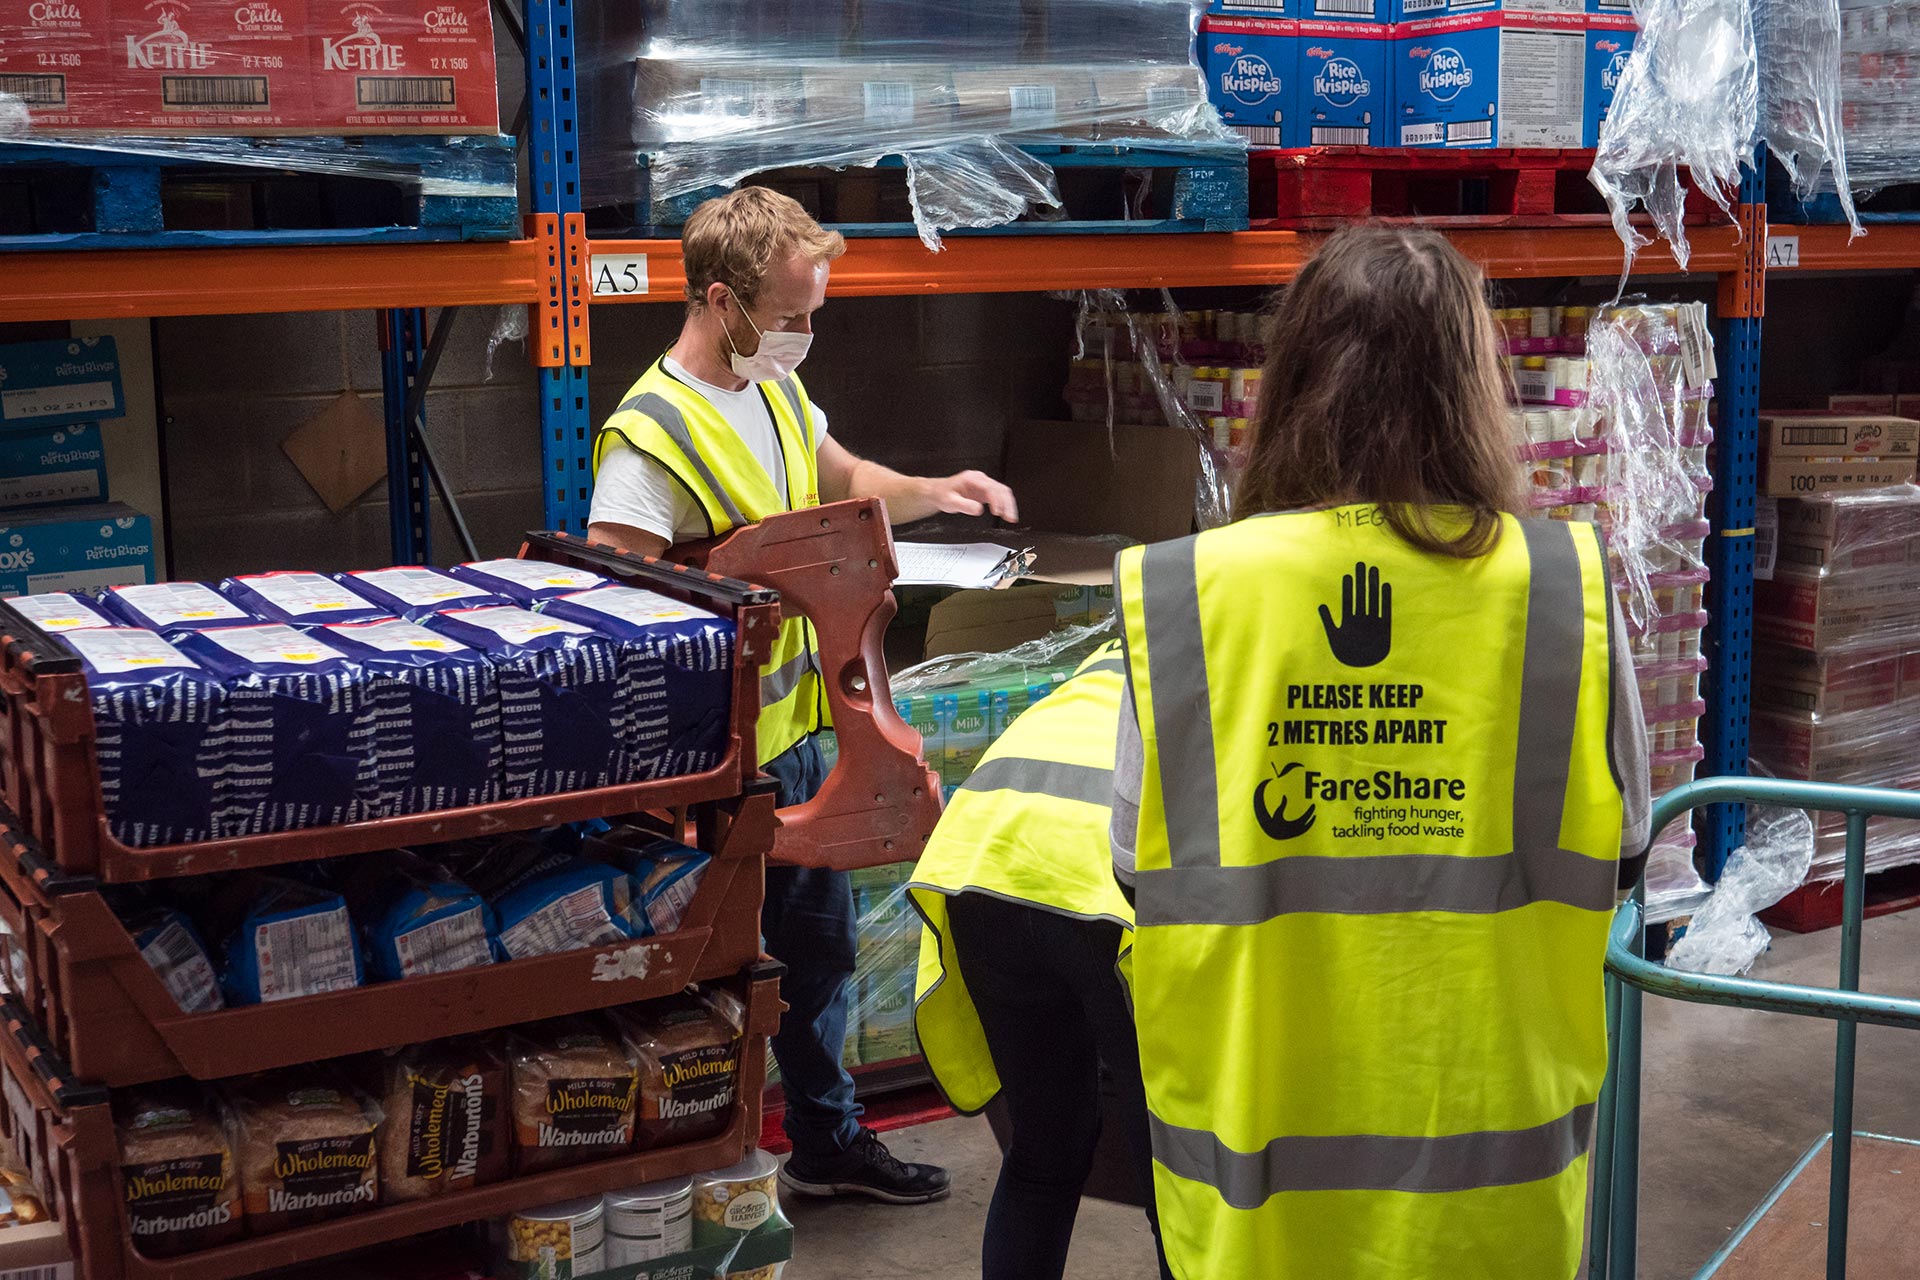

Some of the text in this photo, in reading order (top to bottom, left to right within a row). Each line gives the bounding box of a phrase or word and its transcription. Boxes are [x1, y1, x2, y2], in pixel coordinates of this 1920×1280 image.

[29, 3, 82, 20] Chilli
[235, 8, 284, 25] Chilli
[423, 11, 469, 28] Chilli
[37, 53, 47, 66] 12
[125, 34, 215, 69] KETTLE
[322, 37, 406, 71] KETTLE
[430, 58, 468, 70] 12 X 150G
[1237, 59, 1267, 76] Rice
[1328, 62, 1357, 79] Rice
[1433, 54, 1459, 71] Rice
[1768, 243, 1794, 266] A7
[594, 263, 639, 293] A5
[85, 544, 149, 560] Party Rings
[1099, 585, 1112, 596] Mi
[718, 632, 728, 670] MEDIUM
[591, 644, 606, 682] MEDIUM
[467, 665, 479, 706] MEDIUM
[186, 681, 197, 723] MEDIUM
[229, 690, 274, 700] MEDIUM
[1287, 684, 1424, 710] PLEASE KEEP
[501, 703, 542, 714] MEDIUM
[470, 715, 500, 730] MEDIU
[956, 717, 981, 730] Milk
[1267, 719, 1448, 747] 2 METRES APART
[504, 744, 544, 755] MEDIUM
[820, 737, 834, 750] ilk
[659, 748, 675, 777] EDIUM
[1304, 770, 1466, 801] FareShare
[1354, 805, 1465, 823] fighting hunger,
[1332, 823, 1465, 841] tackling food waste
[567, 1081, 587, 1091] MILD
[596, 1081, 617, 1089] SOFT
[545, 1089, 632, 1114] Wholemeal
[659, 1086, 736, 1120] Warburton
[418, 1082, 449, 1180] Wholemeal
[450, 1074, 484, 1181] Warburtons
[273, 1151, 373, 1179] Wholemeal
[127, 1172, 226, 1202] Wholemeal
[268, 1179, 375, 1213] Warburtons
[730, 1211, 767, 1222] HARVEST
